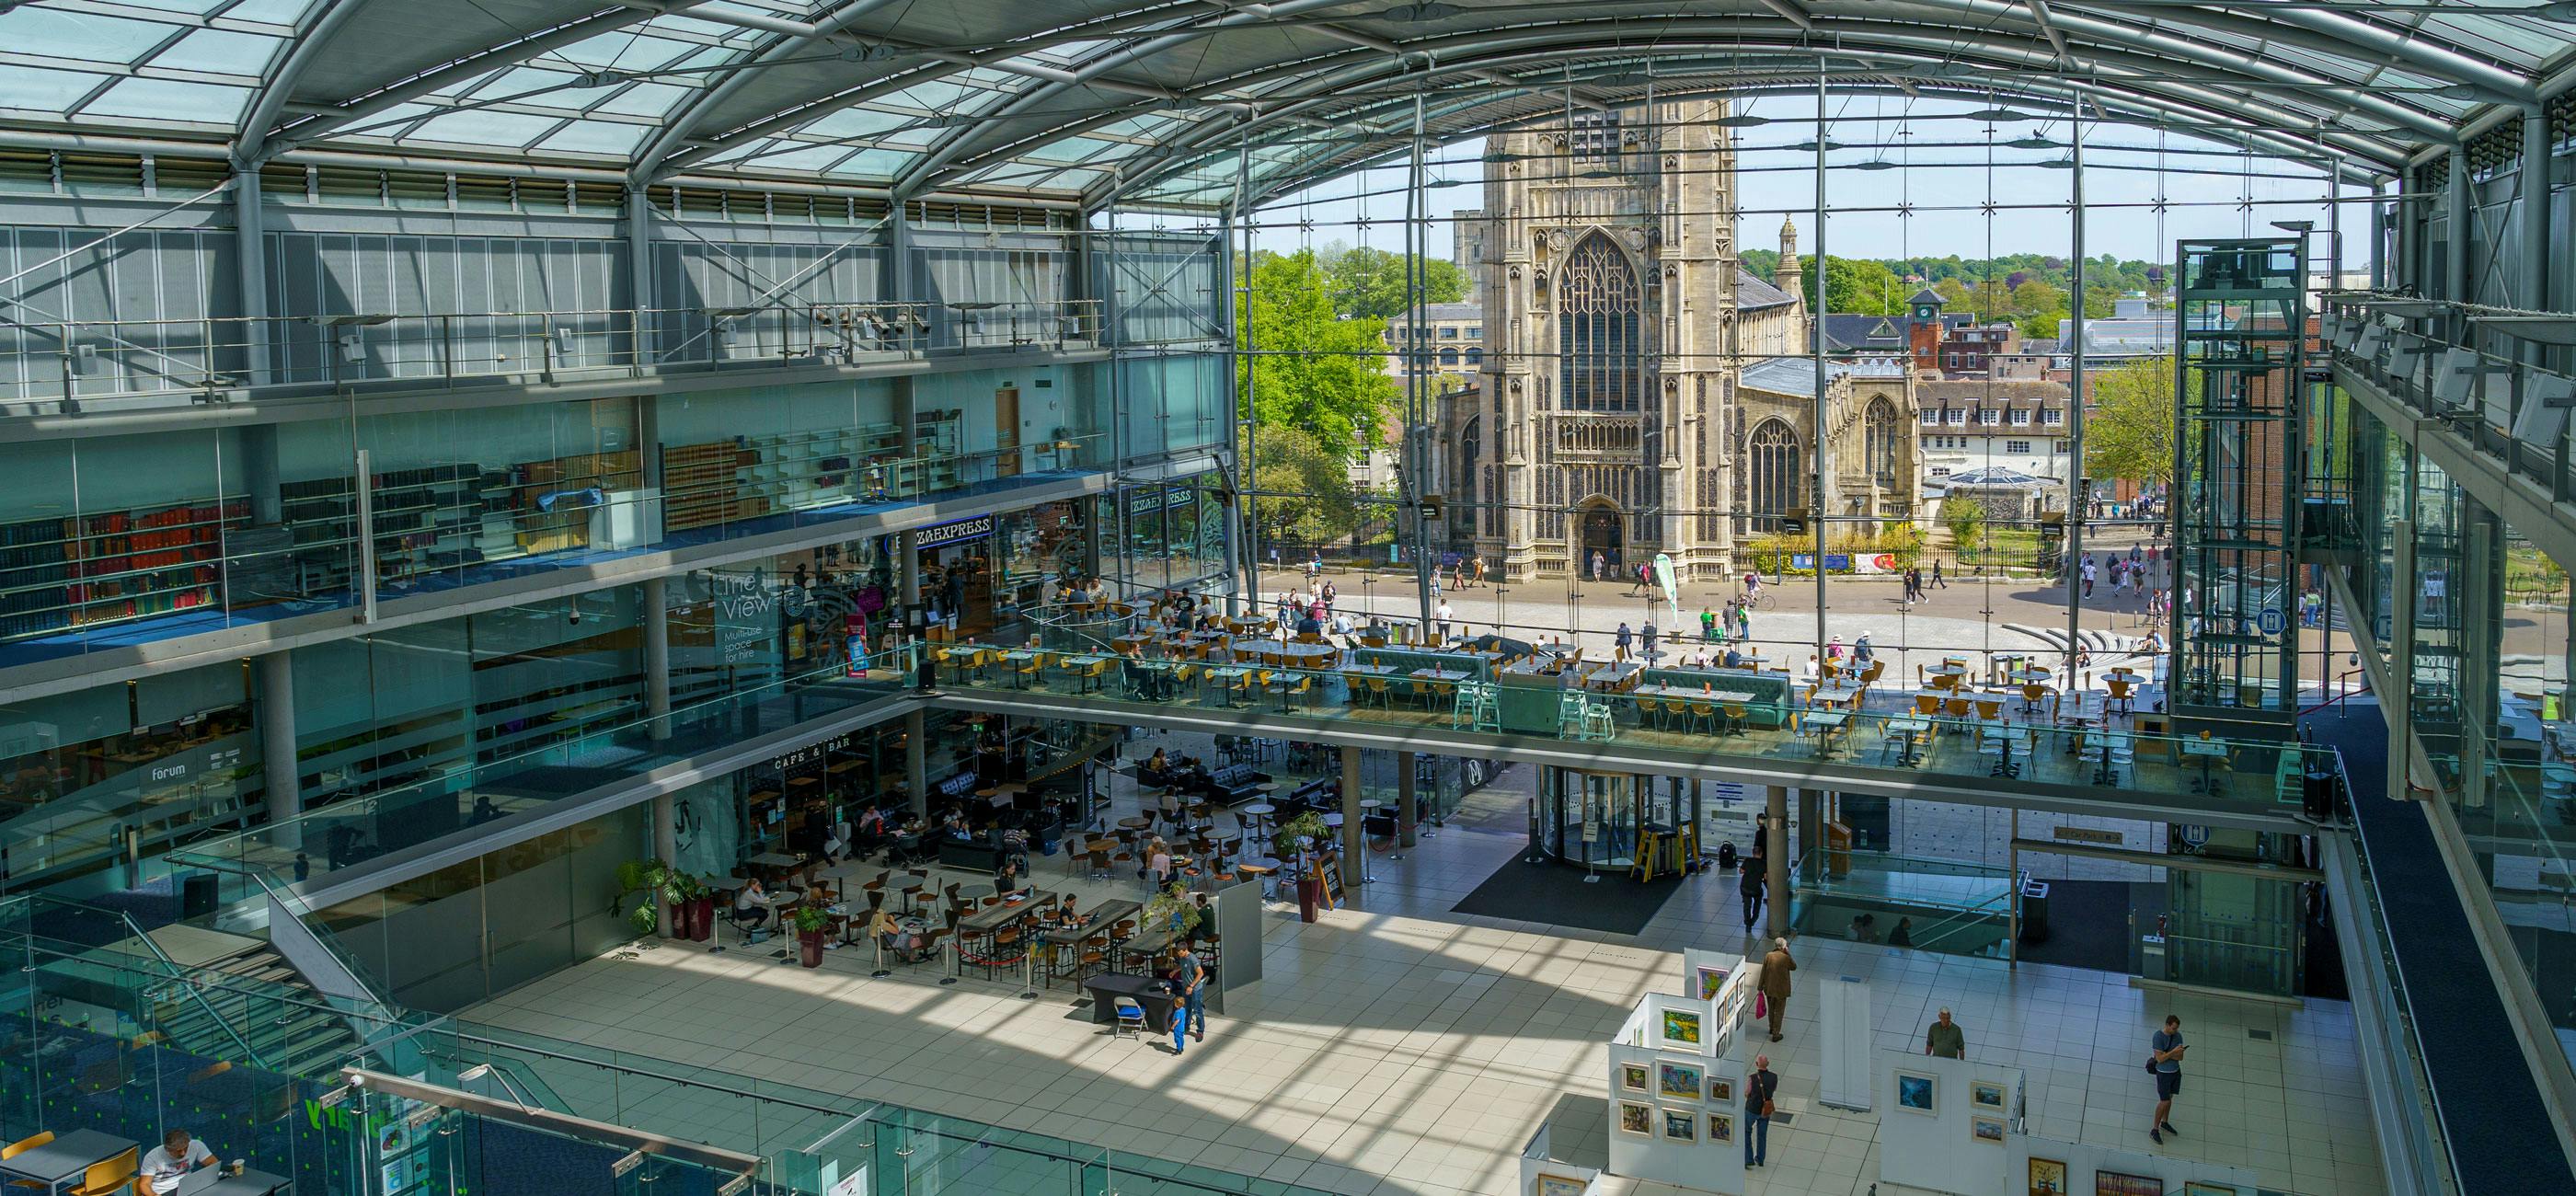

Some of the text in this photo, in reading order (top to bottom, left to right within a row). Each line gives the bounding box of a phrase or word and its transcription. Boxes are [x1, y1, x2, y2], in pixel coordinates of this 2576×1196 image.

[722, 597, 771, 620] View
[724, 626, 762, 642] Multi-use
[724, 639, 752, 654] space
[725, 649, 754, 663] for hire
[813, 747, 820, 757] &
[829, 738, 849, 752] BAR
[152, 765, 185, 780] forum
